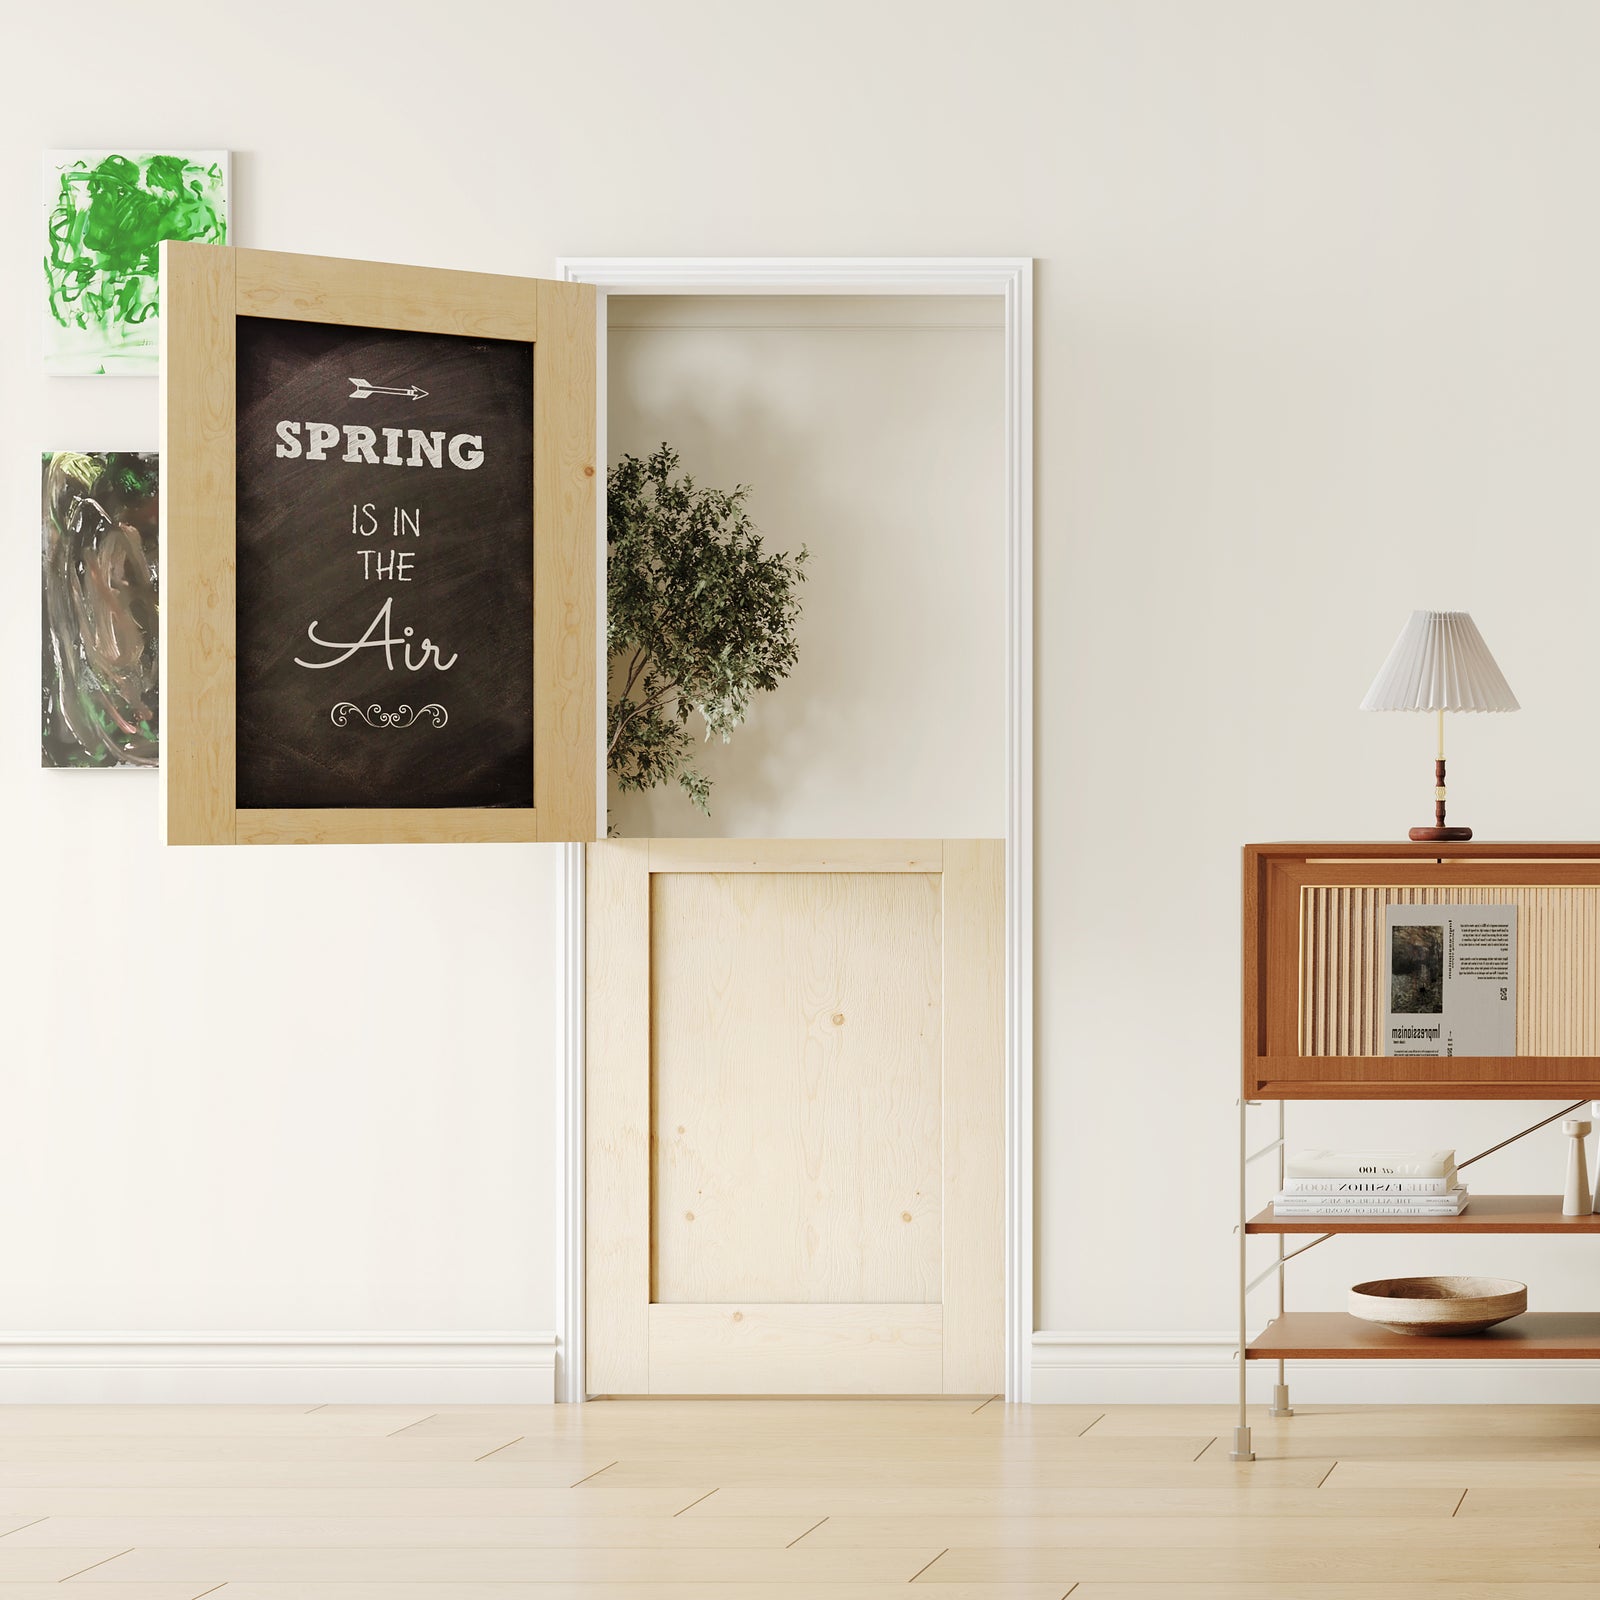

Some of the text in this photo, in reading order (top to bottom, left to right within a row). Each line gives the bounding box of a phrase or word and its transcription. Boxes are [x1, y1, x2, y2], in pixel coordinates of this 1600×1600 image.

[275, 419, 485, 471] SPRING
[352, 503, 420, 537] IS IN
[356, 549, 415, 582] THE
[293, 597, 458, 671] Air
